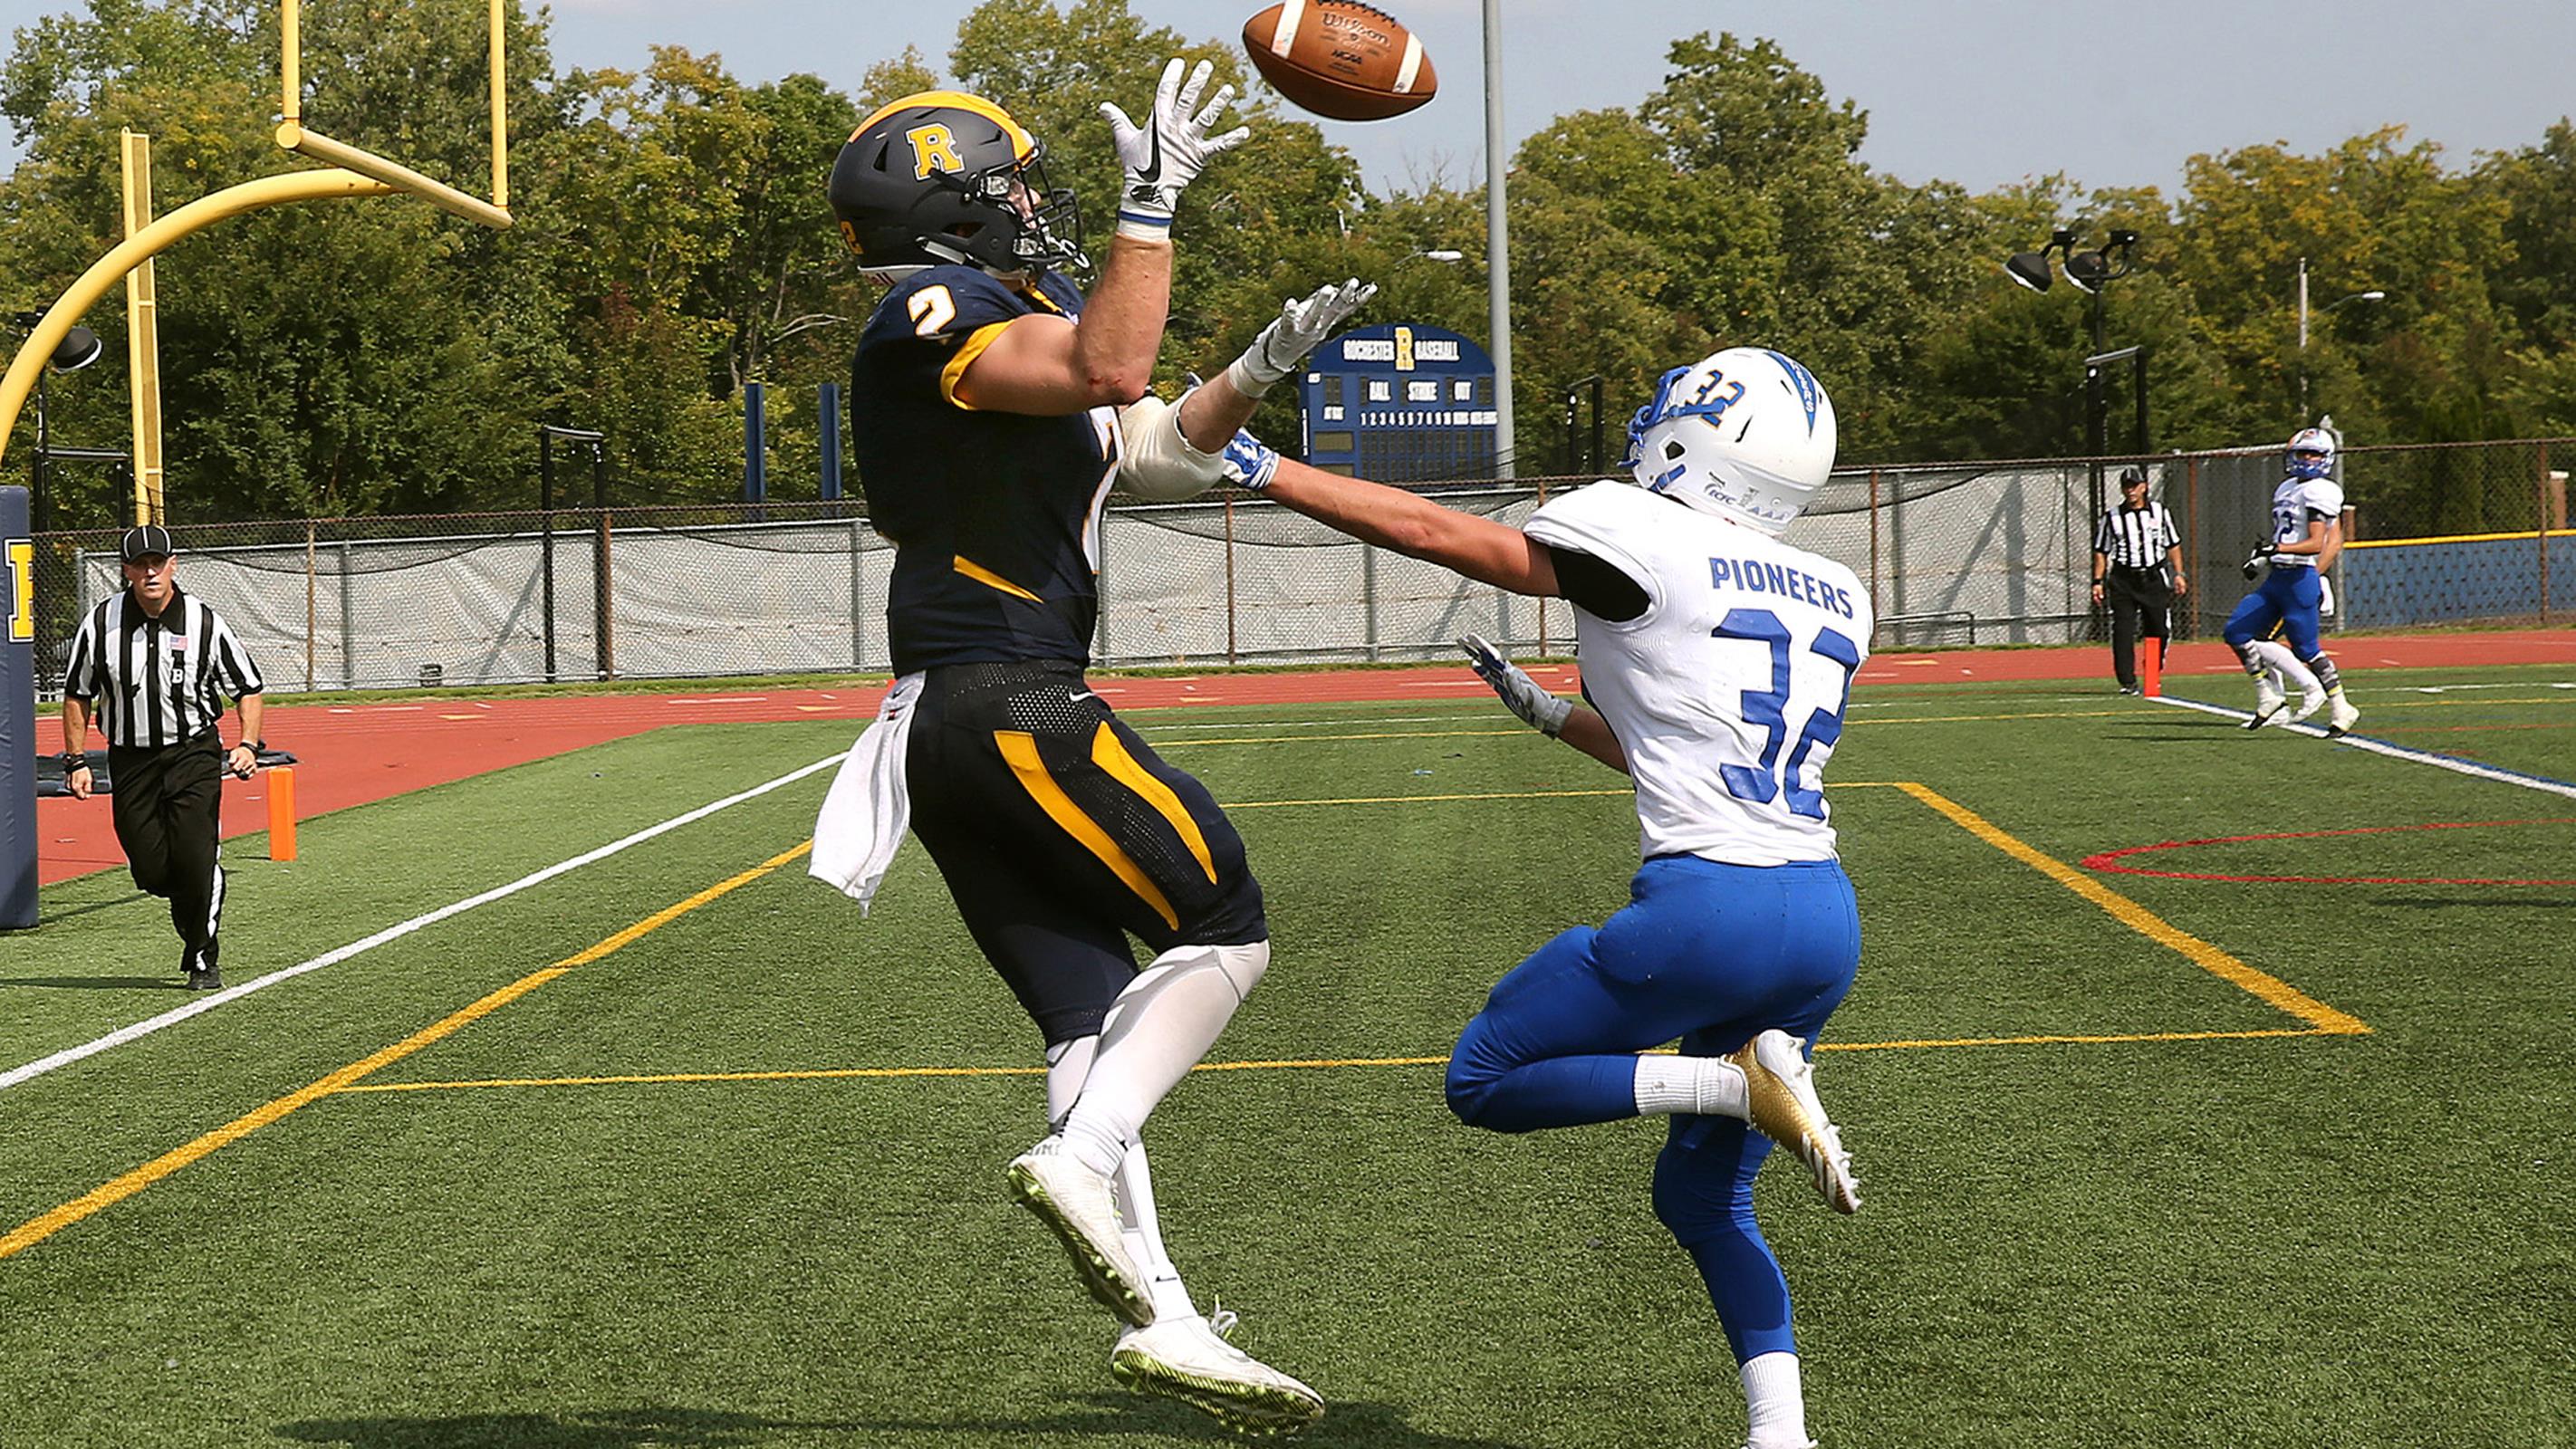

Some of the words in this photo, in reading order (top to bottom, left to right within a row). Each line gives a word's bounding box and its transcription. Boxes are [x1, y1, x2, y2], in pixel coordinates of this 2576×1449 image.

[1322, 12, 1391, 48] Wilson
[906, 122, 966, 180] R
[907, 284, 956, 341] 2
[1395, 326, 1415, 370] R
[1709, 557, 1853, 620] PIONEERS
[1711, 608, 1860, 820] 32
